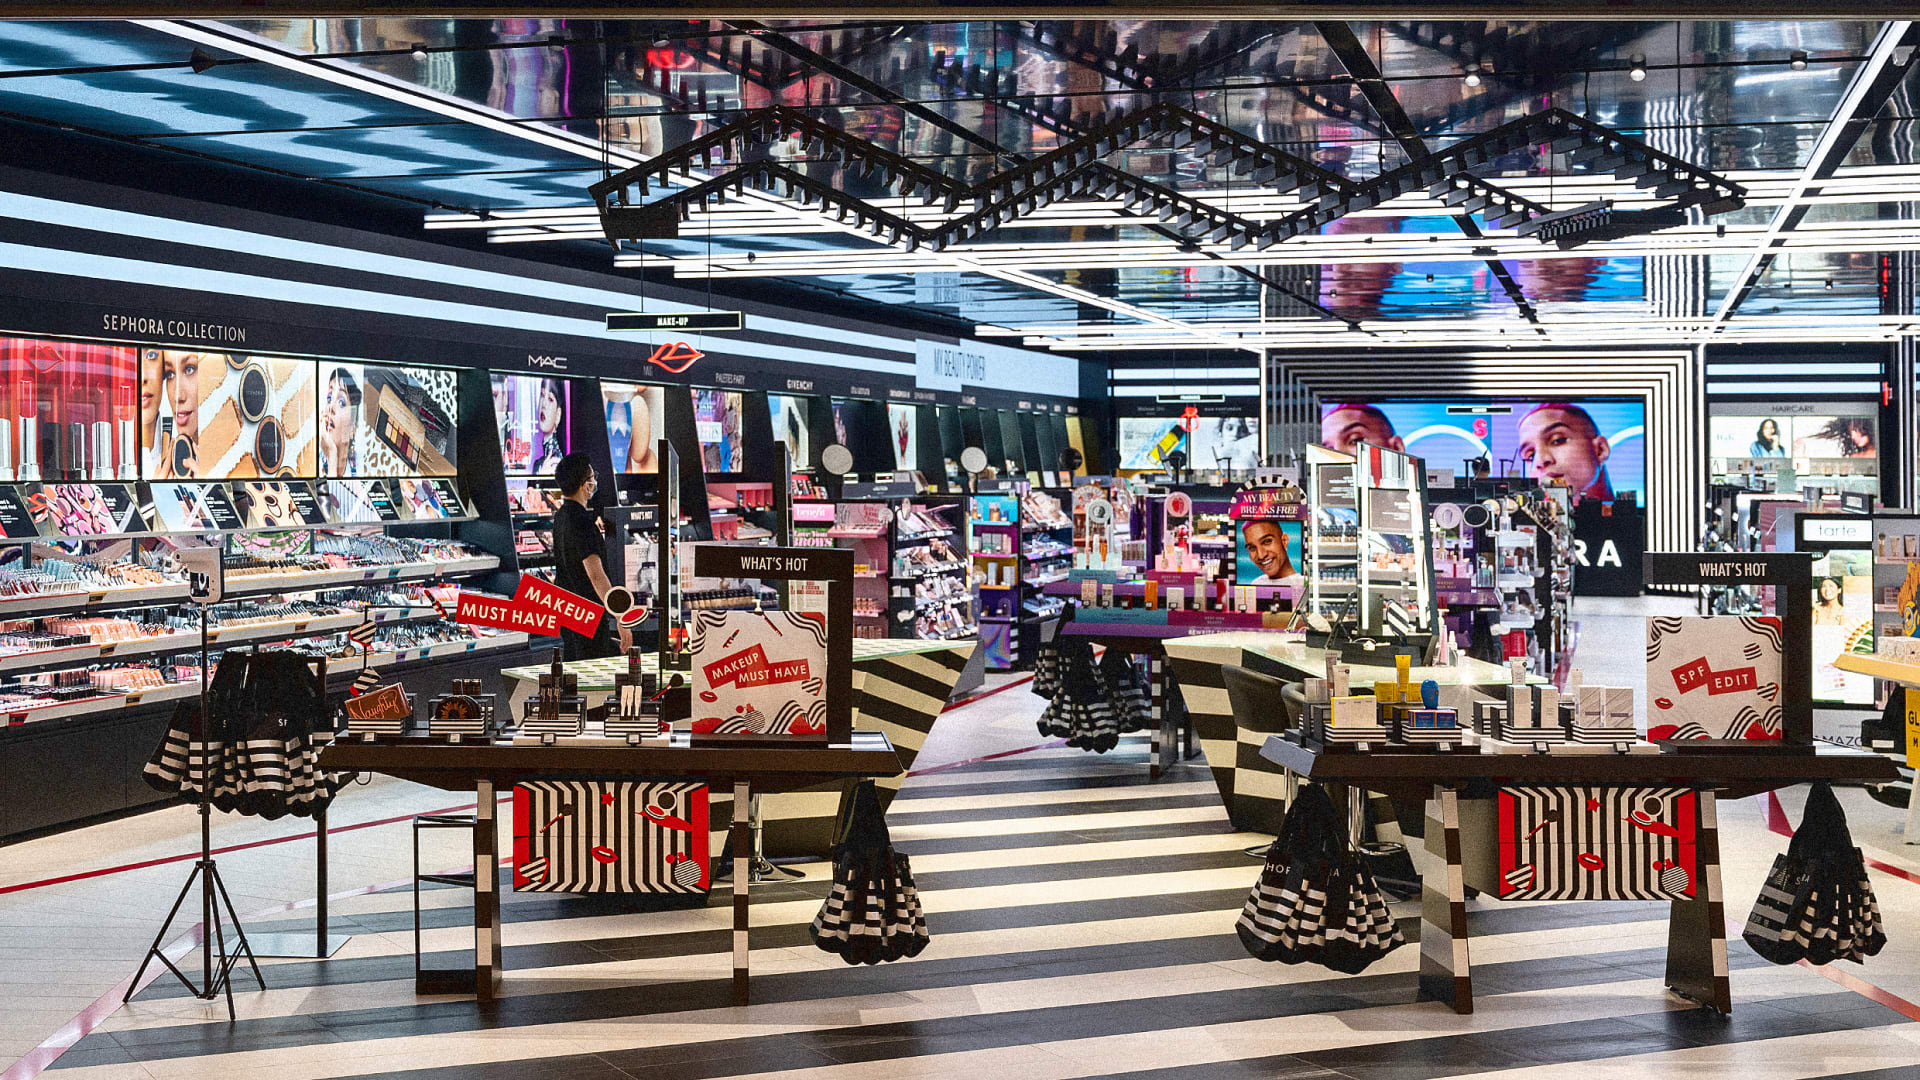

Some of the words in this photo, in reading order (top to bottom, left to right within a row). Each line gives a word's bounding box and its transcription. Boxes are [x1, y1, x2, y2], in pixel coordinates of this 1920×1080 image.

[103, 314, 164, 335] SEPHORA
[168, 320, 246, 342] COLLECTION
[657, 316, 689, 326] MAKE-UP
[528, 355, 568, 370] MAC
[787, 379, 813, 391] GIVENCHY
[1771, 405, 1814, 413] HAIRCARE
[1243, 494, 1260, 503] MY
[1259, 492, 1294, 502] BEAUTY
[630, 511, 645, 521] WHAT'S
[645, 511, 653, 521] HOT
[1240, 505, 1274, 514] BREAKS
[1276, 505, 1299, 514] FREE
[1818, 523, 1857, 537] tarte
[741, 556, 782, 571] WHAT'S
[785, 558, 808, 572] HOT
[1699, 562, 1742, 577] WHAT'S
[1744, 563, 1767, 577] HOT
[524, 586, 596, 625] MAKEUP
[461, 603, 507, 622] MUST
[511, 611, 557, 629] HAVE
[711, 652, 759, 680] MAKEUP
[738, 669, 770, 683] MUST
[774, 664, 807, 678] HAVE
[1679, 665, 1705, 685] SPF
[1715, 673, 1749, 689] EDIT
[349, 689, 400, 719] Naughty
